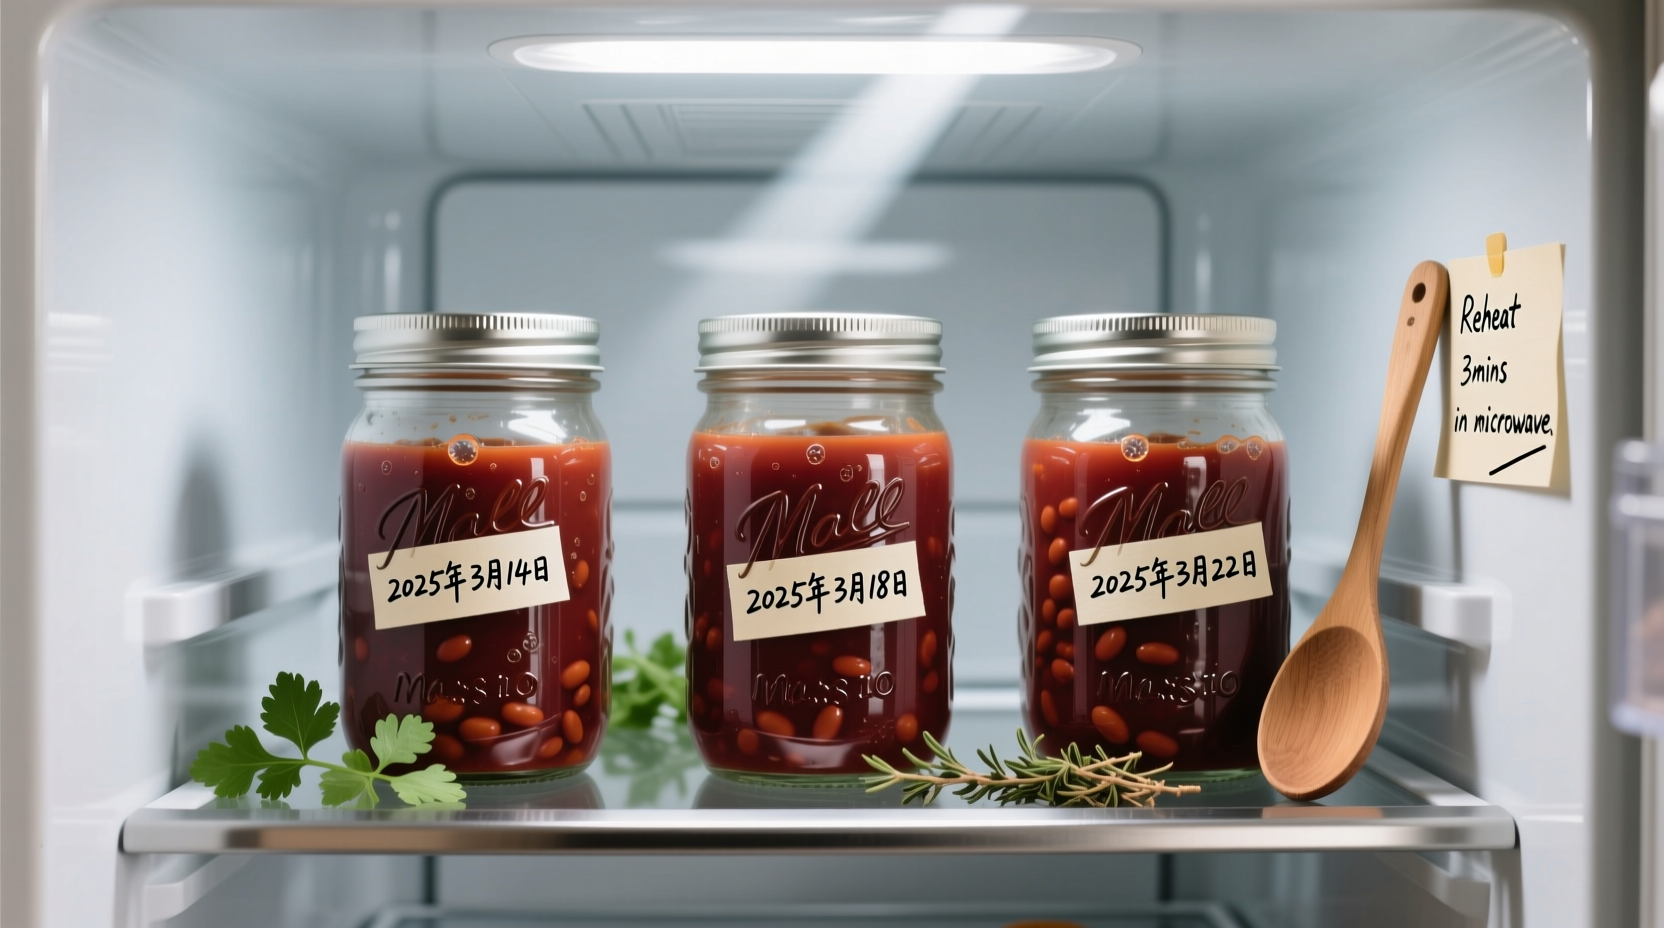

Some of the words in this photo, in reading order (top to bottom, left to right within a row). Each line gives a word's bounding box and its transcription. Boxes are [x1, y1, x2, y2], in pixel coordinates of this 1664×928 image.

[1460, 292, 1522, 335] Reheat
[1460, 354, 1508, 387] 3mins
[1454, 406, 1468, 433] in
[387, 555, 550, 604] 2025年3月14日
[746, 569, 908, 615] 2025年3月18日
[1089, 549, 1258, 600] 2025年3月22日
